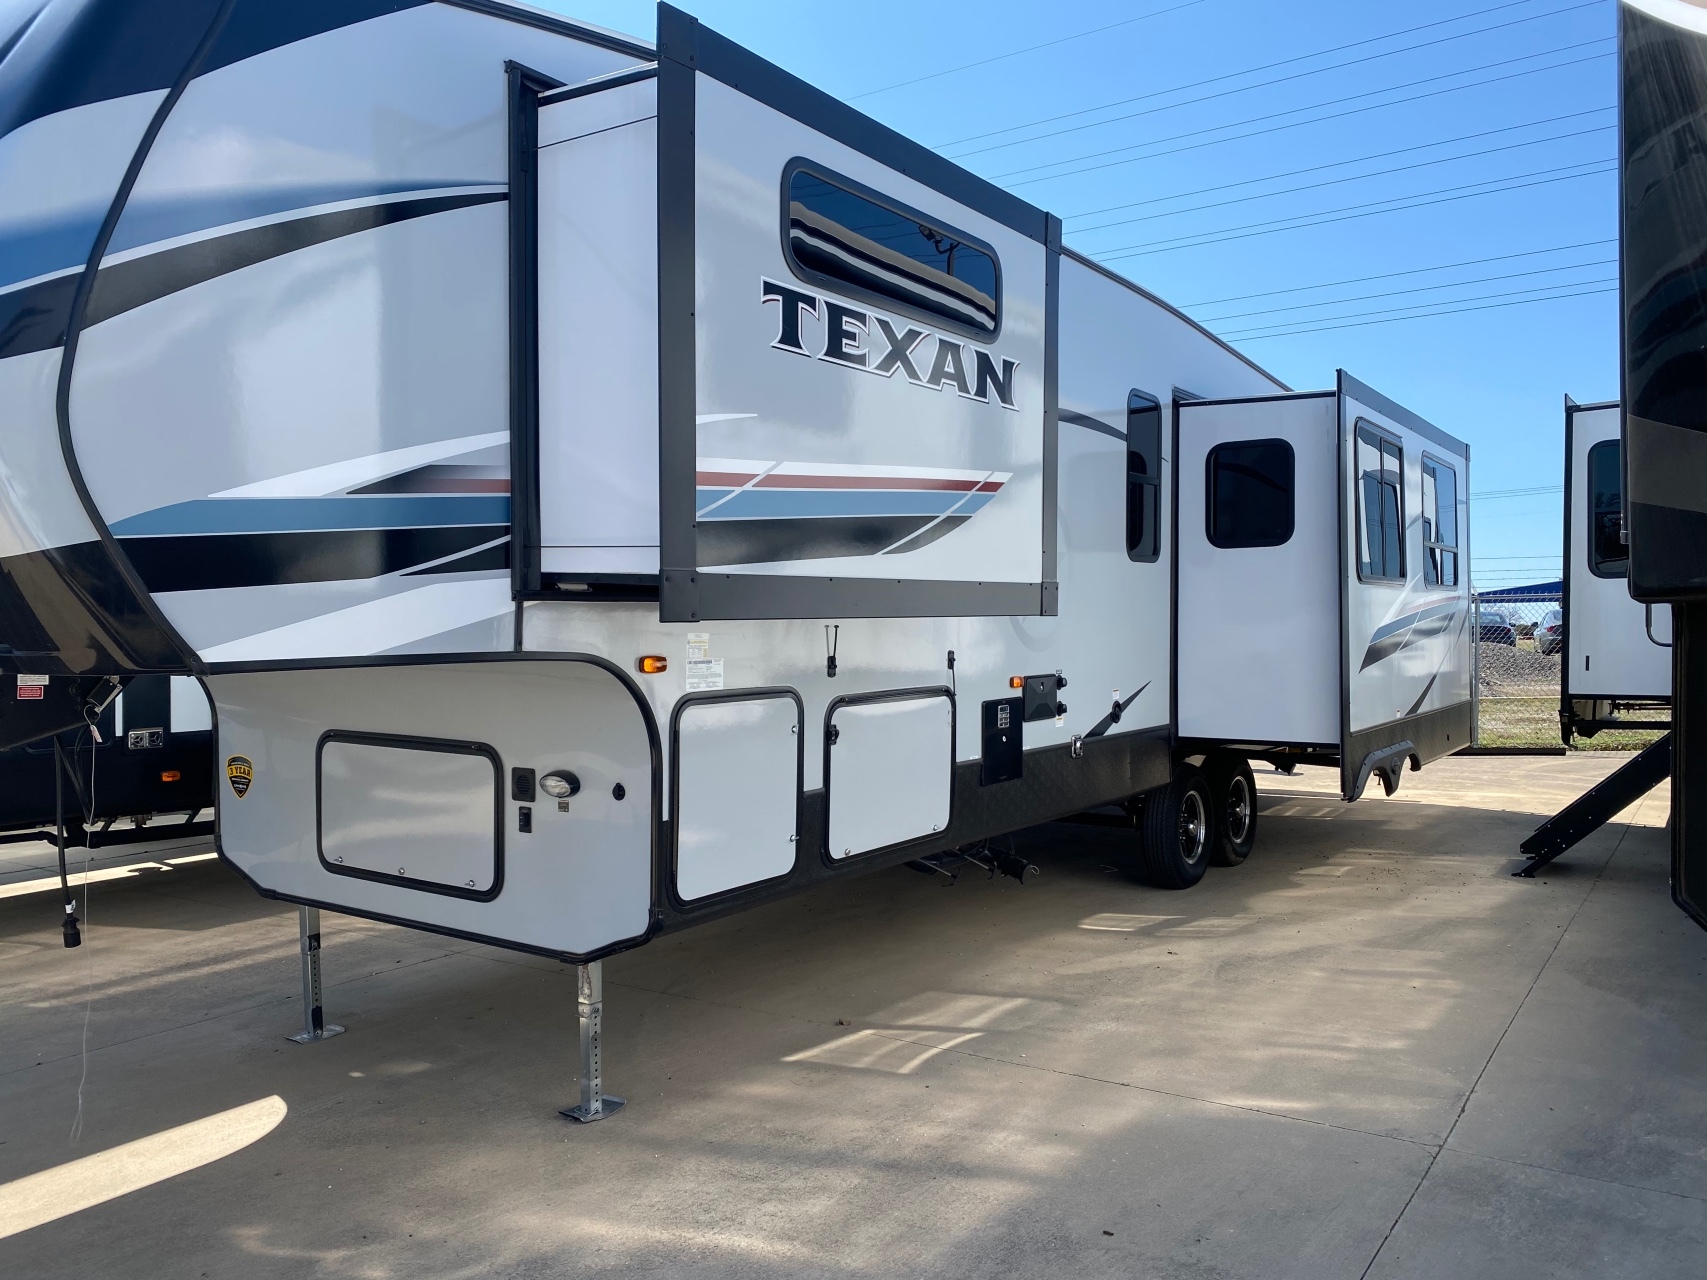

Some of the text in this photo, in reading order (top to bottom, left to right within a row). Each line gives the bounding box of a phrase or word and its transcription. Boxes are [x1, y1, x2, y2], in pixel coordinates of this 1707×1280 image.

[761, 275, 1020, 411] TEXAN
[229, 766, 251, 778] 3 YEAR
